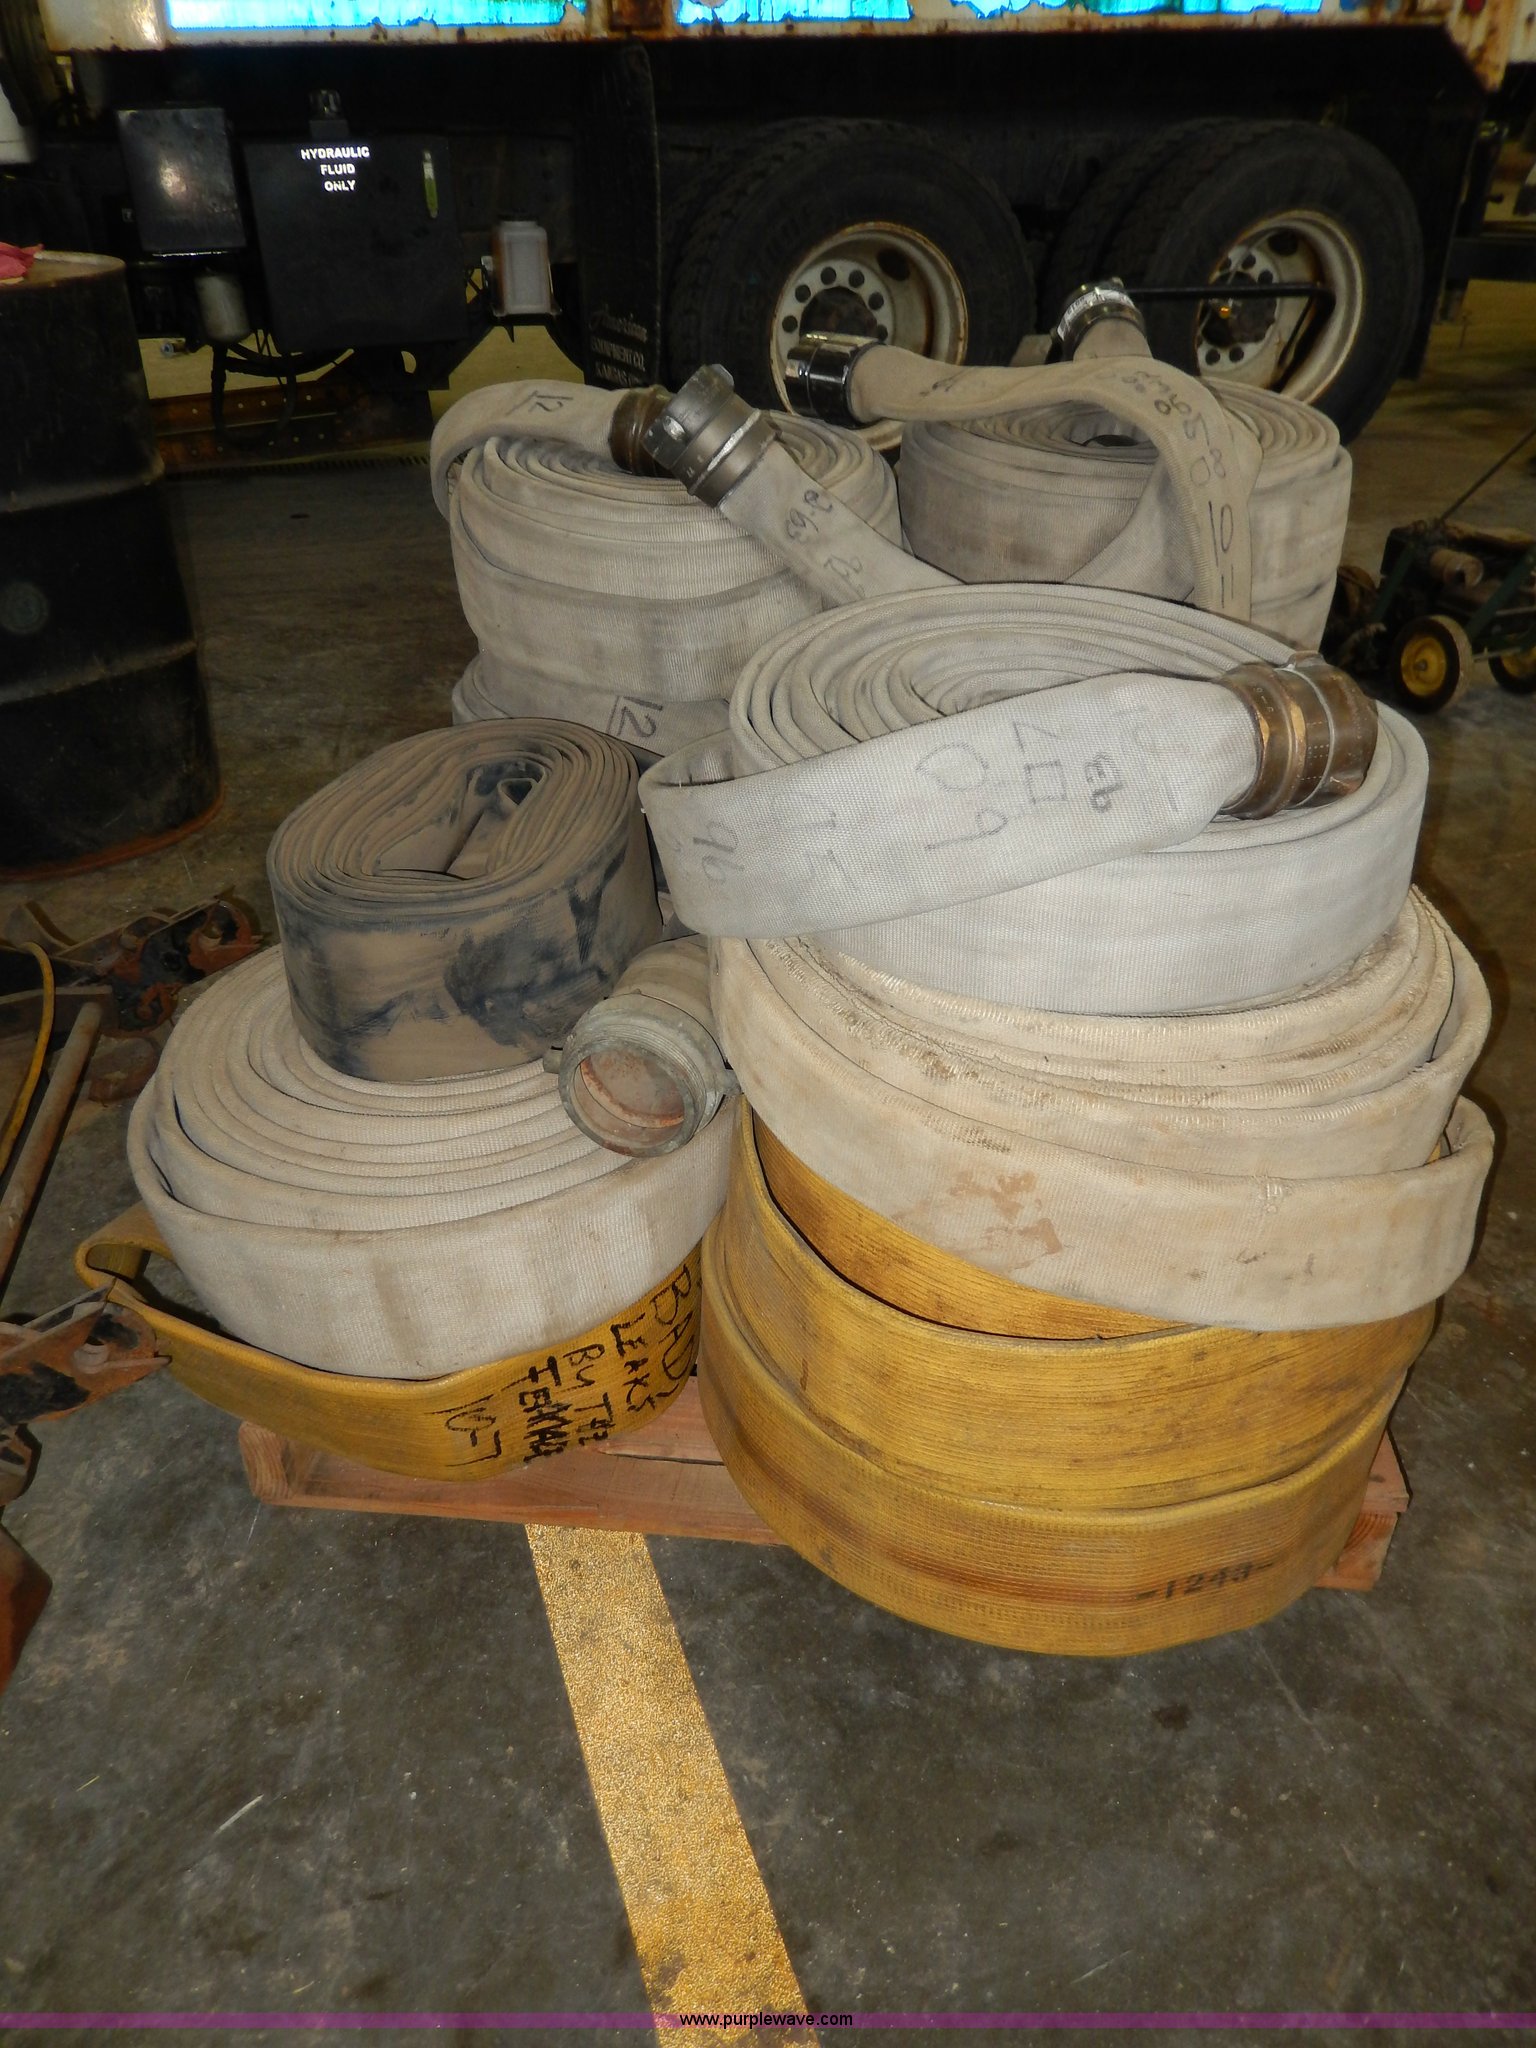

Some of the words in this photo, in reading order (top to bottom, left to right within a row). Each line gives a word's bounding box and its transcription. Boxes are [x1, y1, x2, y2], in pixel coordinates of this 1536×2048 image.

[300, 146, 370, 160] HYDRAULIC
[320, 163, 356, 175] FLUID
[324, 179, 356, 192] ONLY
